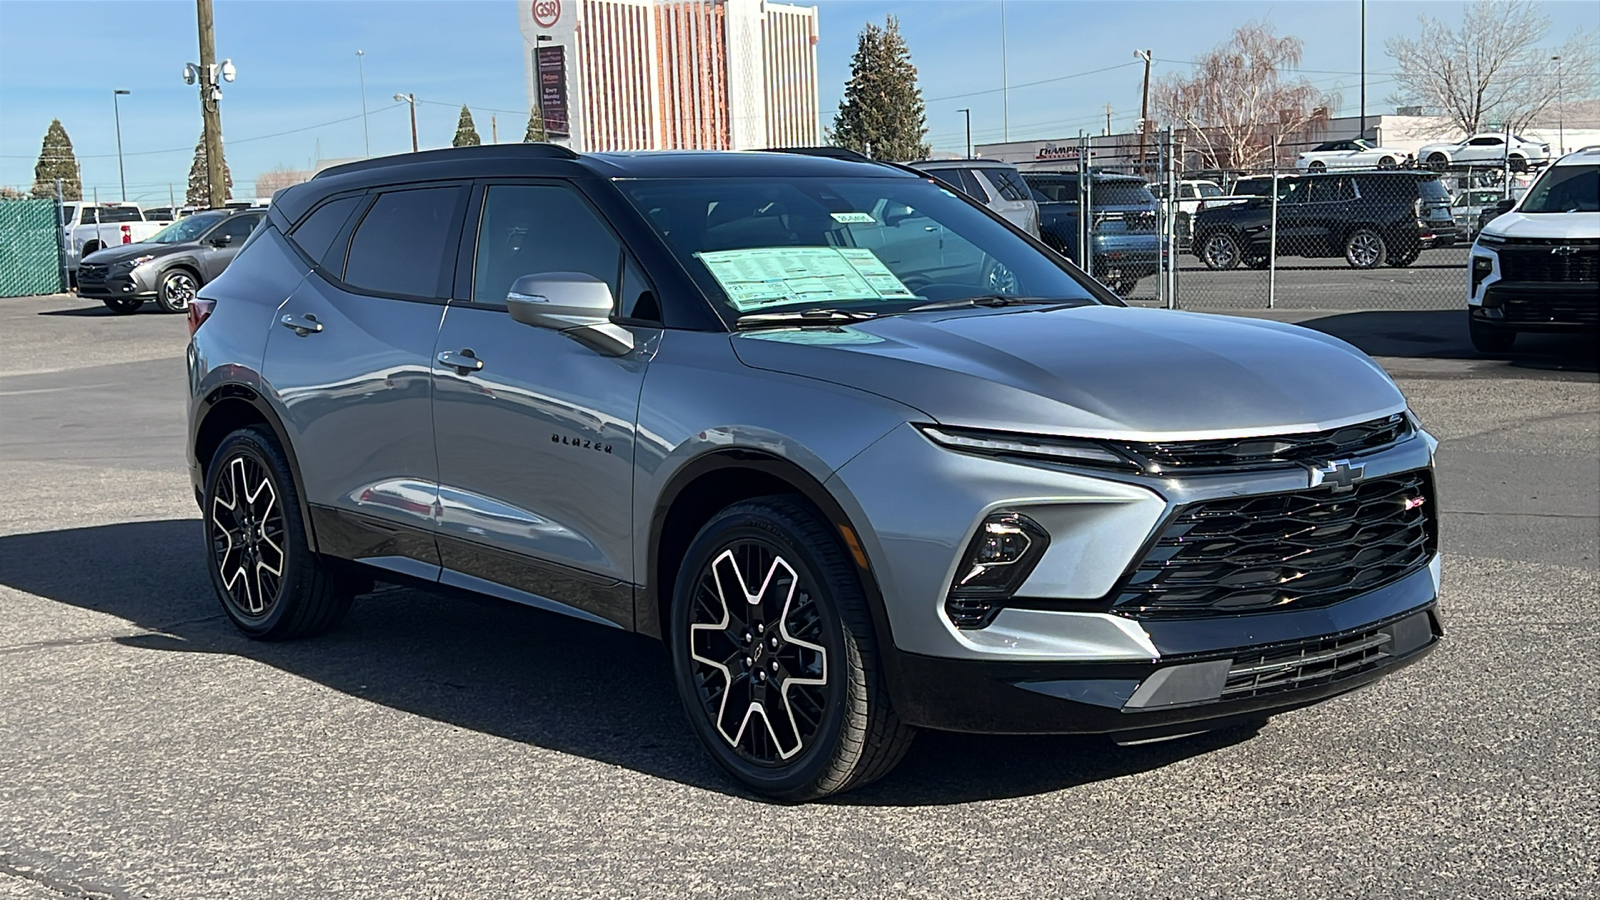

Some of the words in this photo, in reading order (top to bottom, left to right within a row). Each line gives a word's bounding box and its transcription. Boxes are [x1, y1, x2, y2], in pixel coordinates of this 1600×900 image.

[536, 1, 557, 17] GSR
[1039, 145, 1088, 157] CHAMPI
[551, 433, 612, 454] BLAZER
